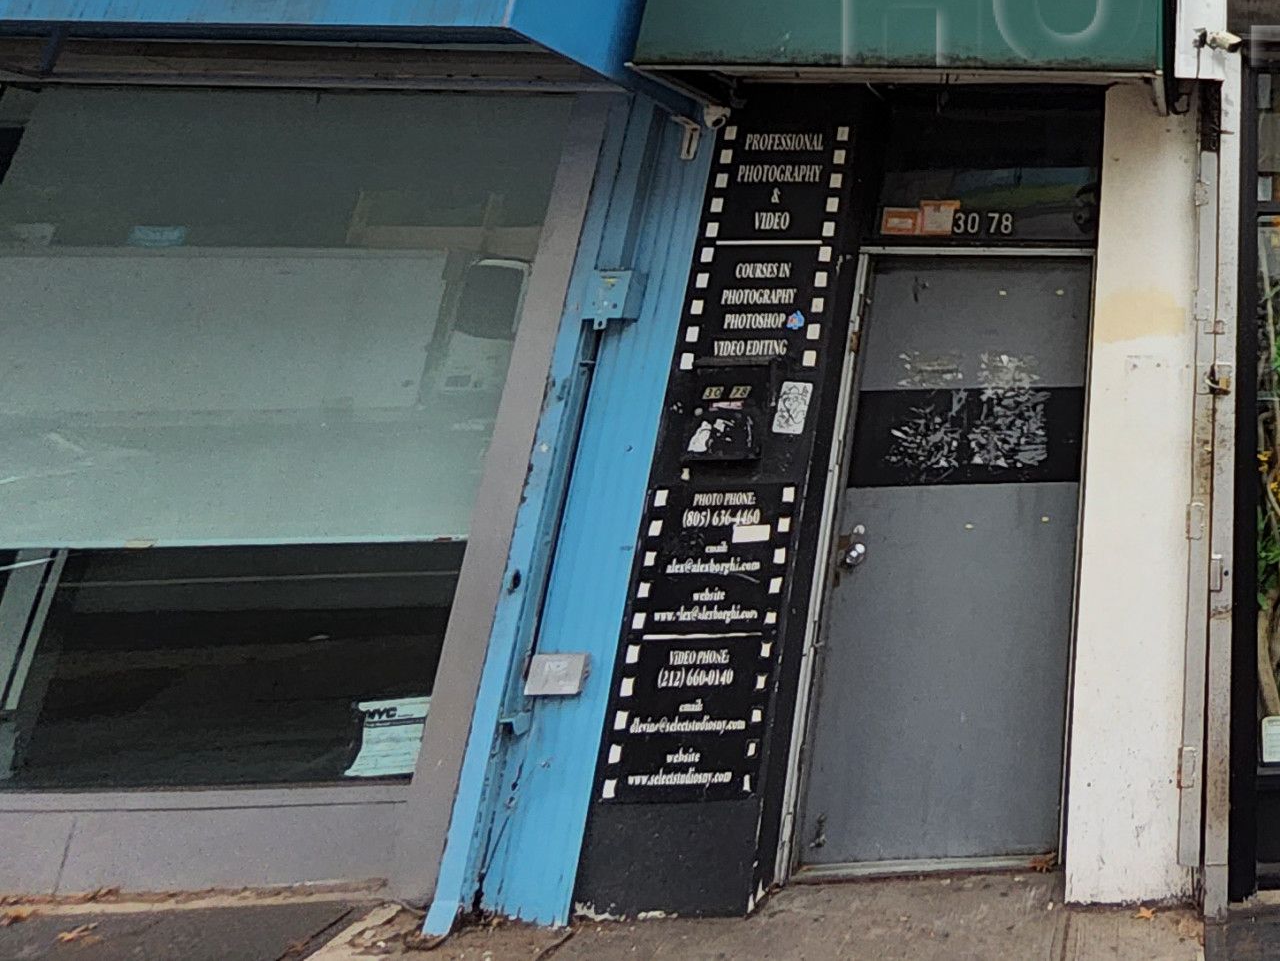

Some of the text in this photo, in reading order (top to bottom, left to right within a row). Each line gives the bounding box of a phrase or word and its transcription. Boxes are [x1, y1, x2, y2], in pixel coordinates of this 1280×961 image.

[745, 134, 824, 151] PROFESSIONAL
[737, 165, 823, 182] PHOTOGRAPHY
[770, 187, 781, 204] &
[754, 212, 790, 230] VIDEO
[953, 212, 979, 233] 30
[988, 212, 1013, 234] 78
[735, 262, 791, 279] COURSES IN
[721, 289, 797, 305] PHOTOGRAPHY
[723, 313, 786, 329] PHOTOSHOP
[714, 339, 788, 356] VIDEO EDITING
[693, 493, 724, 506] PHOTO
[682, 508, 761, 528] (805) 636-4460
[669, 650, 697, 665] VIDEO
[658, 667, 734, 688] (212) 660-0140
[365, 707, 398, 720] NYC
